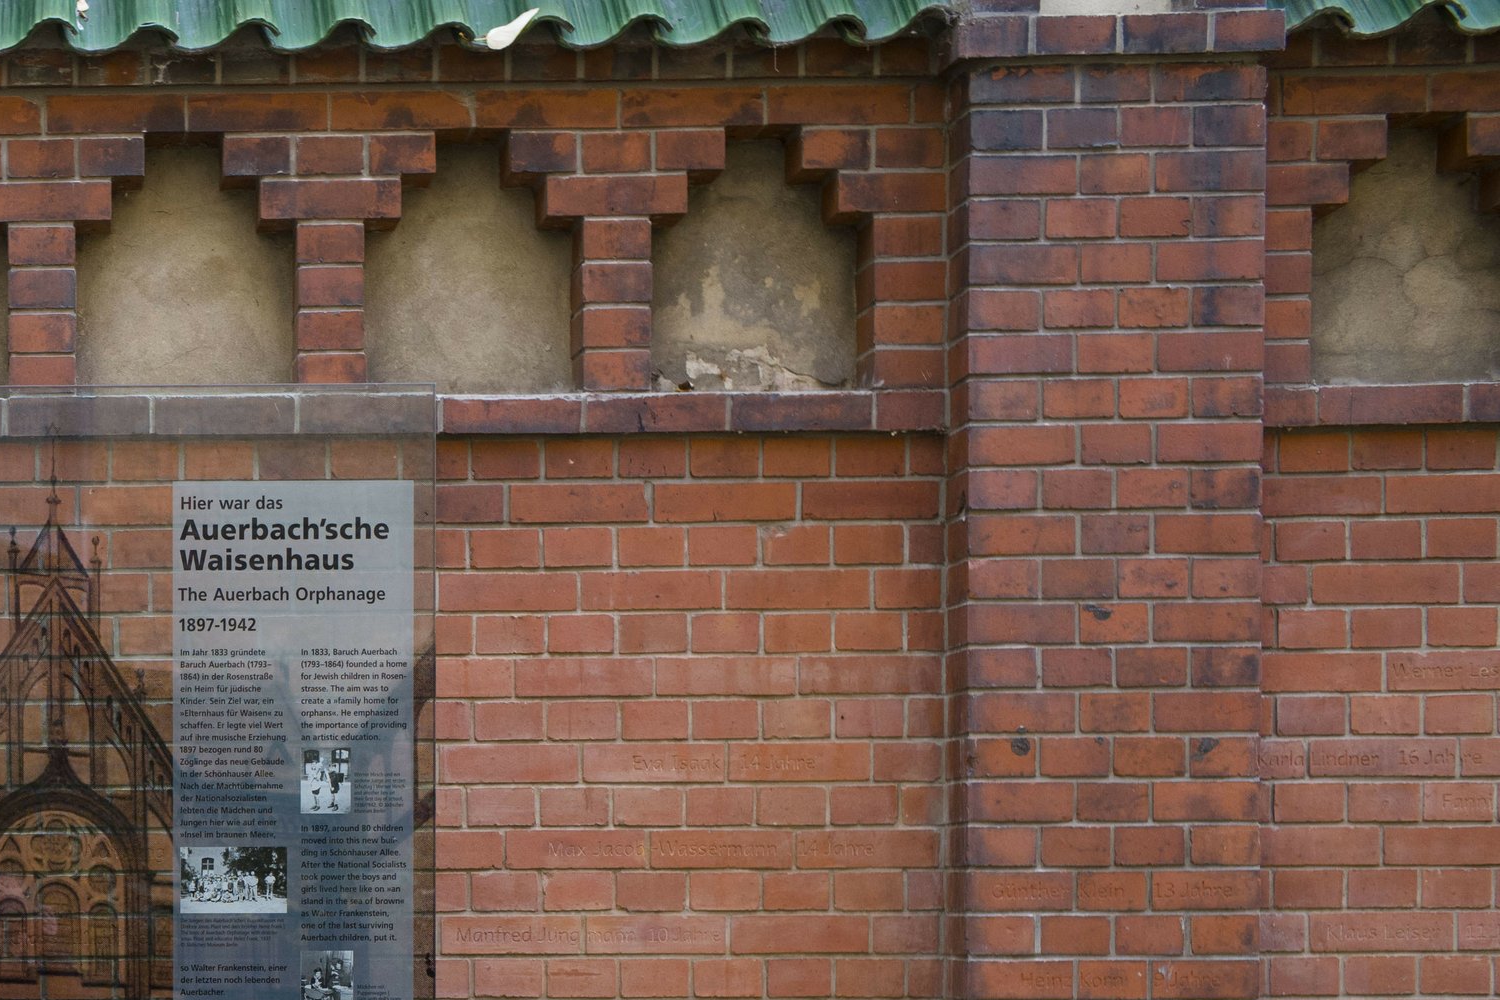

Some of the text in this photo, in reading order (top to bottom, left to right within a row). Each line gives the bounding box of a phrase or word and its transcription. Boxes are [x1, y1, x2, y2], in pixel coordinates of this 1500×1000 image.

[181, 495, 283, 510] Hier war das
[180, 517, 389, 541] Auerbach’sche
[180, 548, 354, 571] Waisenhaus
[178, 586, 386, 604] The Auerbach Orphanage
[179, 617, 257, 632] 1897-1942
[180, 647, 267, 659] Im Jahr 1833 gründete
[300, 647, 309, 656] In
[333, 647, 359, 656] Baruch
[361, 647, 398, 656] Auerbach
[179, 660, 206, 669] Baruch
[209, 660, 245, 669] Auerbach
[346, 659, 378, 668] founded
[386, 659, 407, 668] home
[201, 672, 209, 681] in
[211, 672, 224, 681] der
[226, 672, 273, 681] Rosenstraße
[300, 672, 311, 681] for
[314, 672, 339, 681] Jewish
[340, 672, 370, 681] children
[372, 672, 379, 681] in
[180, 684, 262, 695] ein Heim für jüdische
[226, 708, 238, 717] für
[300, 720, 407, 732] the importance of providing
[180, 745, 263, 756] 1897 bezogen rund 80
[632, 755, 664, 771] Eva
[671, 754, 722, 771] Isaak
[766, 754, 817, 771] Jahre
[180, 781, 284, 790] Nach der Machtübernahme
[548, 841, 586, 857] Max
[825, 840, 875, 857] Jahre
[301, 860, 407, 869] After the National Socialists
[1181, 881, 1233, 898] Jahre
[455, 926, 532, 943] Manfred
[672, 926, 722, 943] Jahre
[191, 963, 216, 972] Walter
[268, 963, 287, 972] einer
